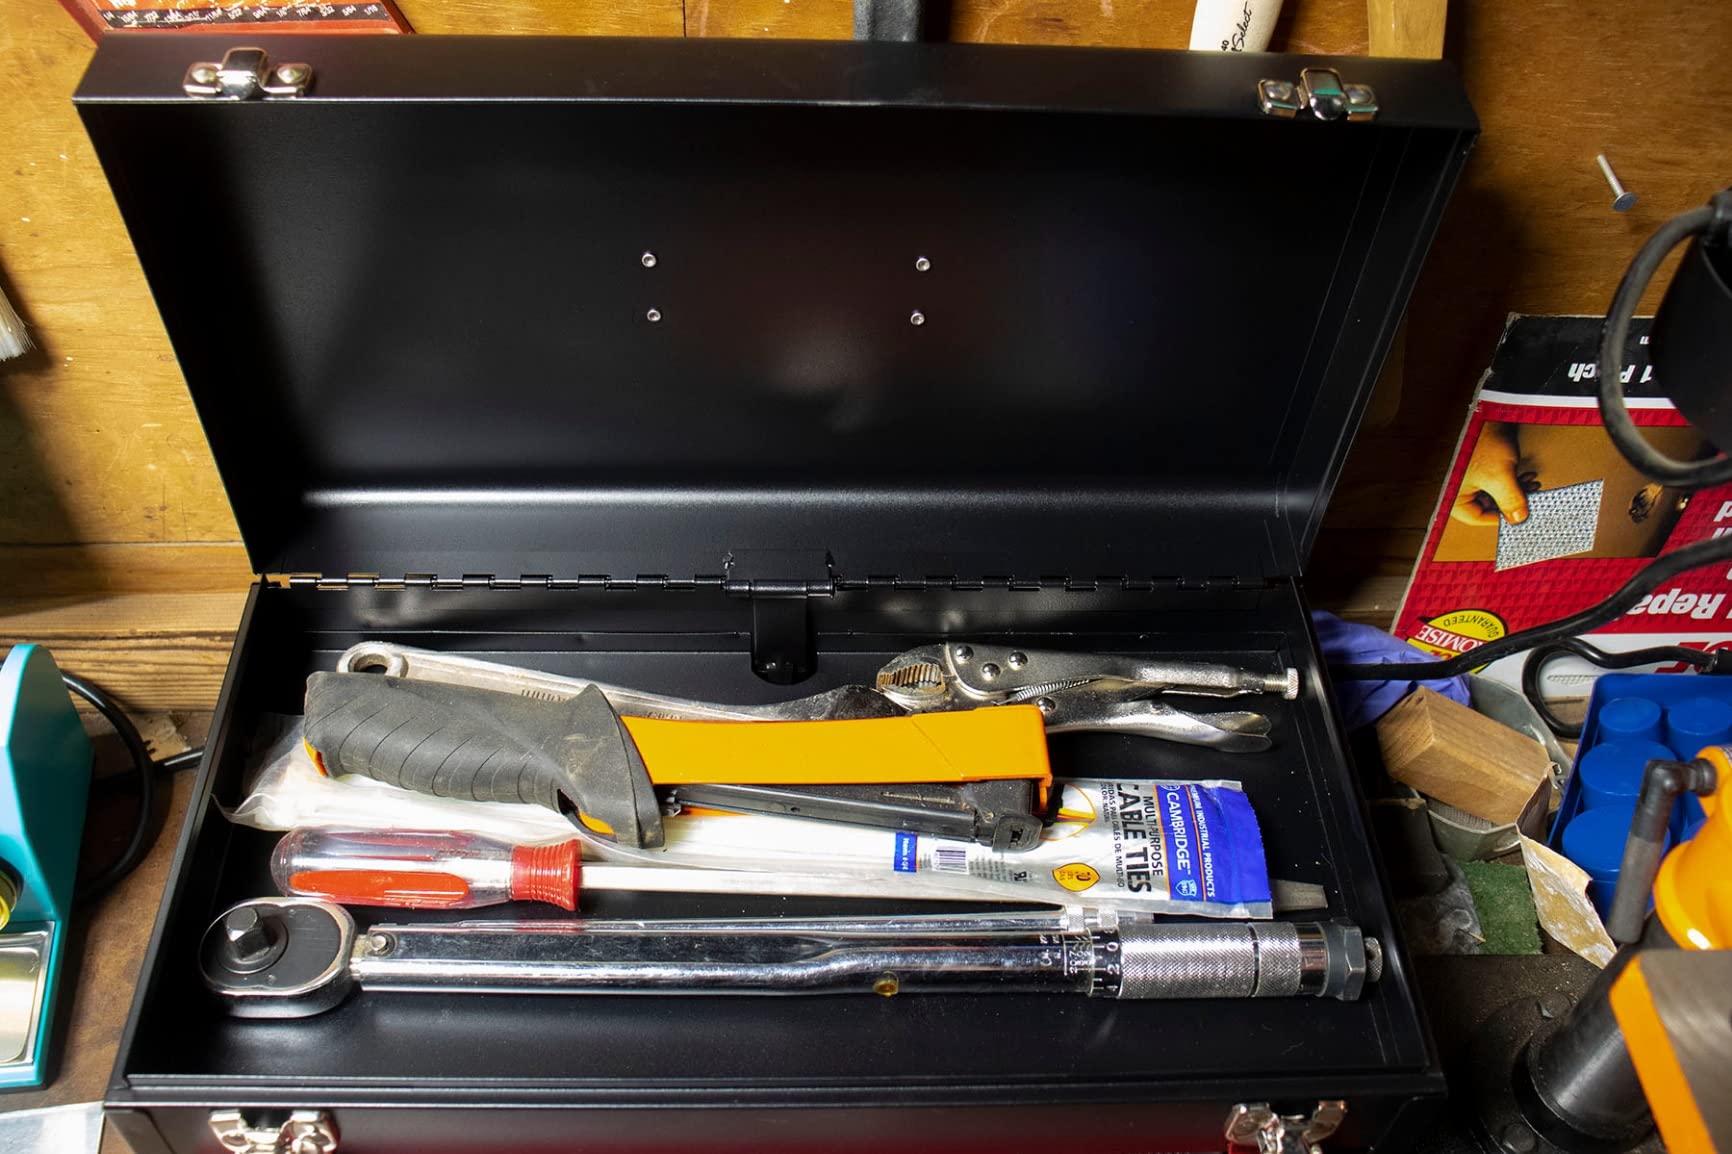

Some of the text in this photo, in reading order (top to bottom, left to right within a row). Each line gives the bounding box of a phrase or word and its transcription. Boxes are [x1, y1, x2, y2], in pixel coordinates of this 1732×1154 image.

[1231, 0, 1252, 48] Select
[1568, 363, 1635, 383] Pch
[1620, 588, 1726, 619] Repa
[1415, 624, 1484, 653] OMISE
[1443, 614, 1500, 638] GUARANTEED
[1143, 796, 1163, 876] MULTI-PURPOSE
[1167, 791, 1190, 870] CAMBRIDGE
[1114, 843, 1122, 853] DE
[1196, 810, 1210, 850] INDUSTRIAL
[1203, 852, 1216, 897] PRODUCTS
[1126, 847, 1152, 892] TIES
[1106, 942, 1119, 952] 0
[1107, 963, 1120, 975] 2
